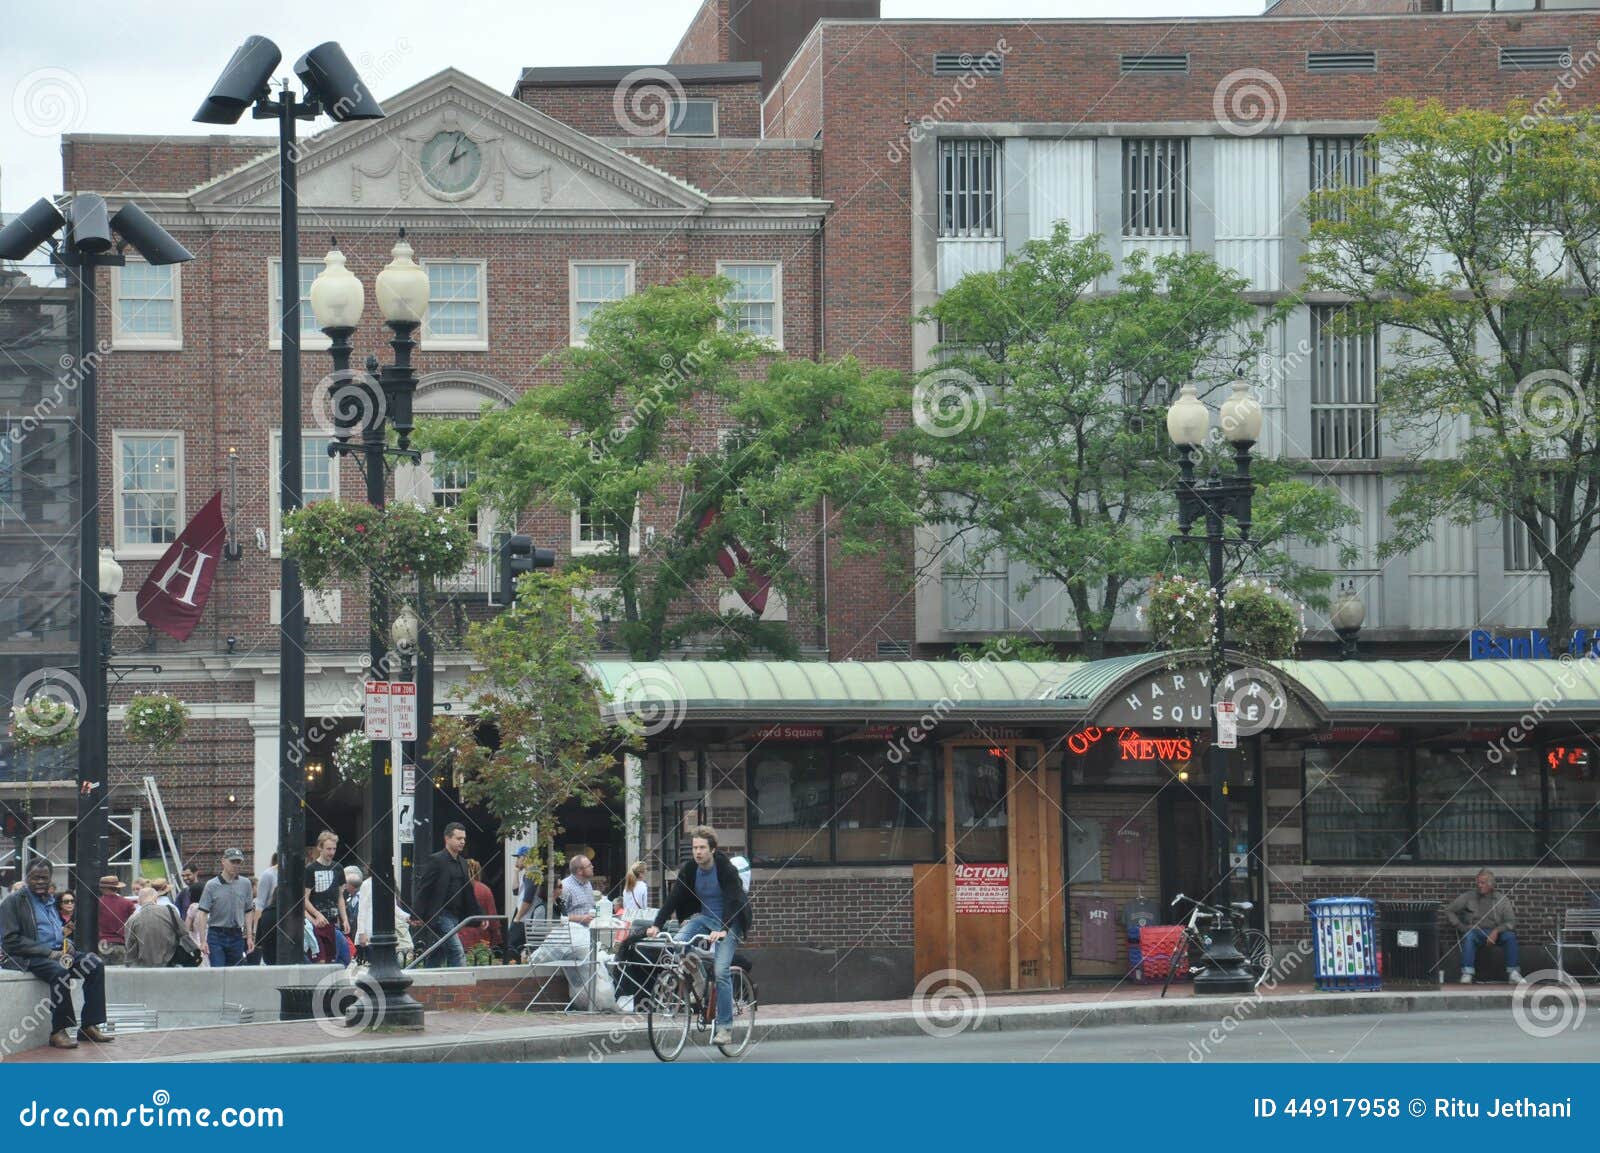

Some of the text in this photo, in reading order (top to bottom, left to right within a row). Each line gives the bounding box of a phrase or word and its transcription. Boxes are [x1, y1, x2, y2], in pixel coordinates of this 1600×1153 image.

[152, 542, 213, 606] H
[1469, 629, 1551, 659] Bank
[1126, 671, 1283, 711] HARVARD
[1152, 705, 1259, 722] SQUE
[752, 727, 824, 740] vard Square
[1120, 739, 1192, 760] NEWS
[955, 864, 1009, 878] ACTION
[1089, 909, 1109, 920] MIT
